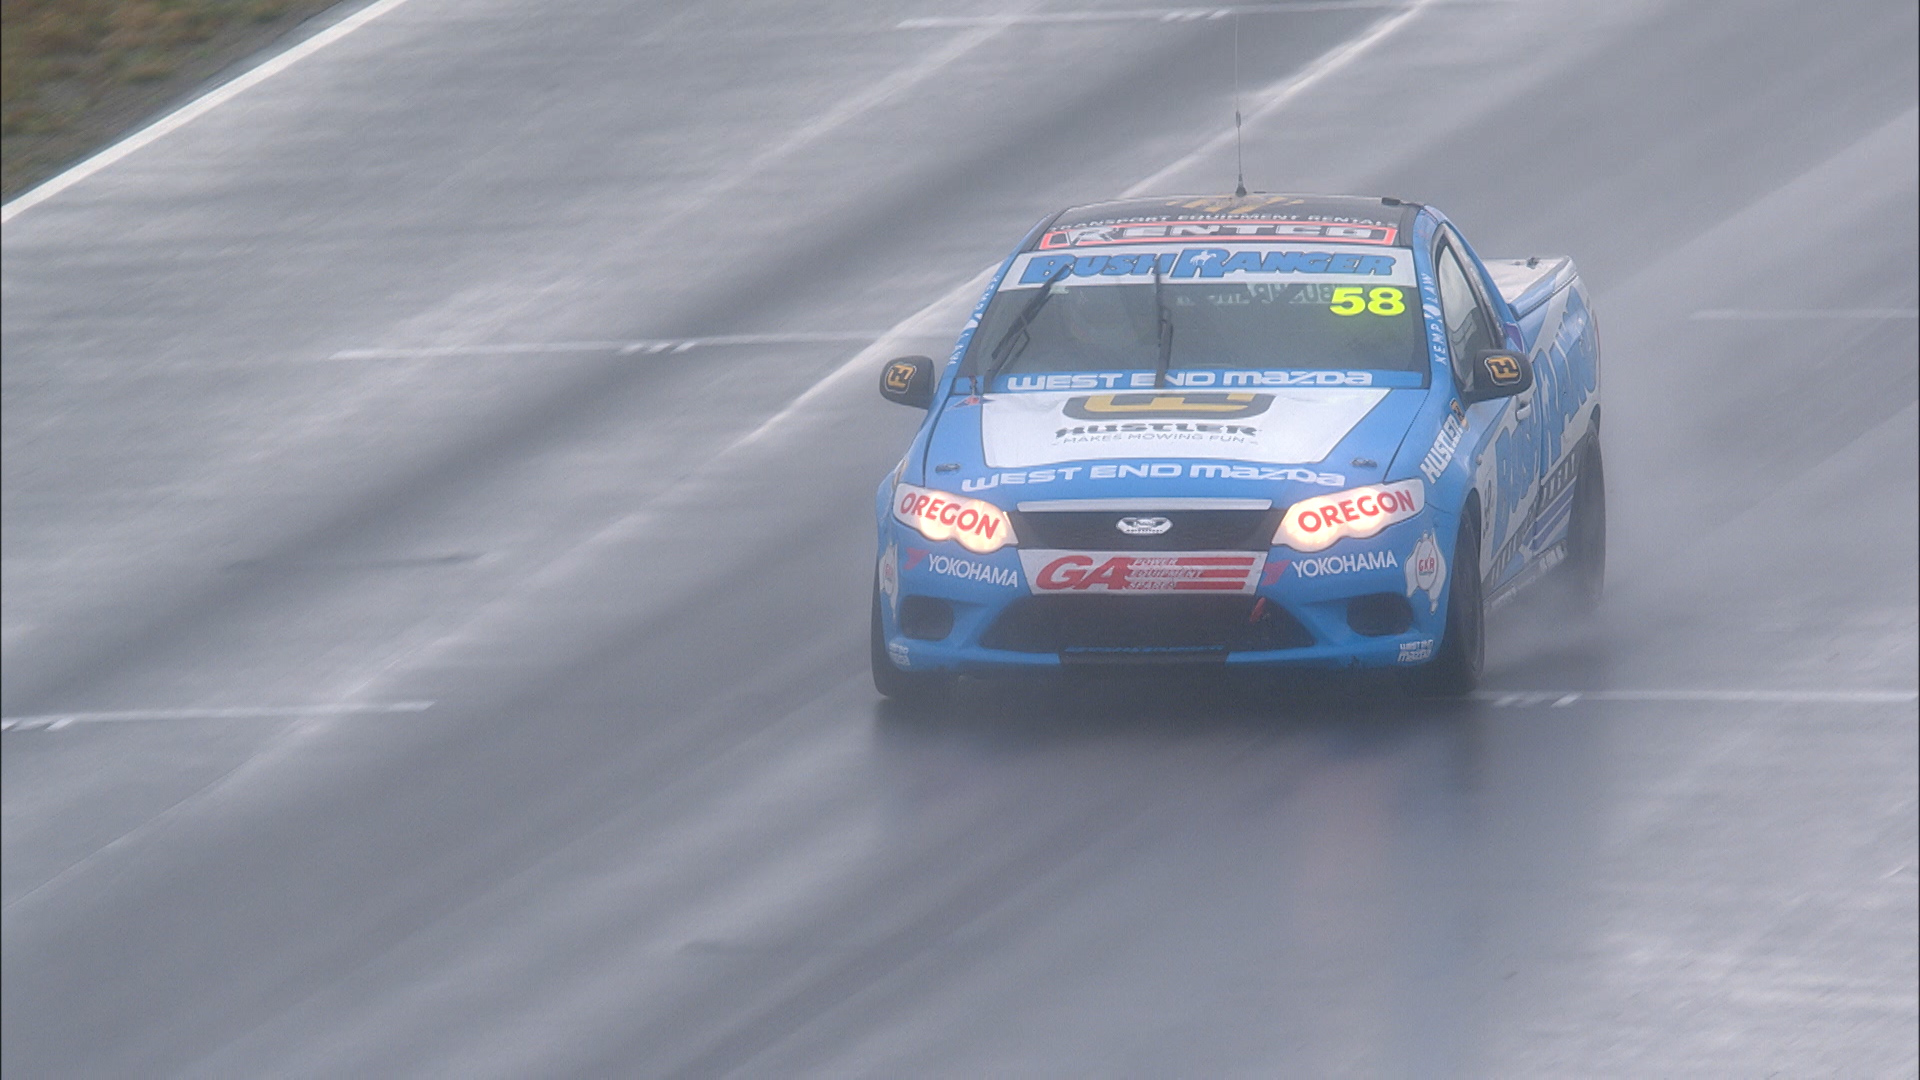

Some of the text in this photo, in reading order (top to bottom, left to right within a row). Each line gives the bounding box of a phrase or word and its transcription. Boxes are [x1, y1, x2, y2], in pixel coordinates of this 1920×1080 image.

[1017, 247, 1397, 285] BUSH RANGER
[1328, 286, 1406, 317] 58
[1007, 373, 1123, 391] WEST
[1130, 373, 1216, 388] END
[1055, 422, 1257, 438] HUSTLER
[1063, 433, 1122, 444] MAKES
[1209, 434, 1245, 444] FUN
[1419, 413, 1463, 484] HUSTLER
[961, 467, 1083, 492] WEST
[1089, 463, 1182, 479] END
[900, 492, 1000, 540] OREGON
[1298, 489, 1416, 533] OREGON
[928, 553, 1018, 588] YOKOHAMA
[1035, 554, 1137, 590] GA
[1130, 569, 1204, 578] EQUIPMENT
[1132, 557, 1179, 566] POWER
[1292, 549, 1398, 578] YOKOHAMA
[1128, 581, 1178, 590] SPARES
